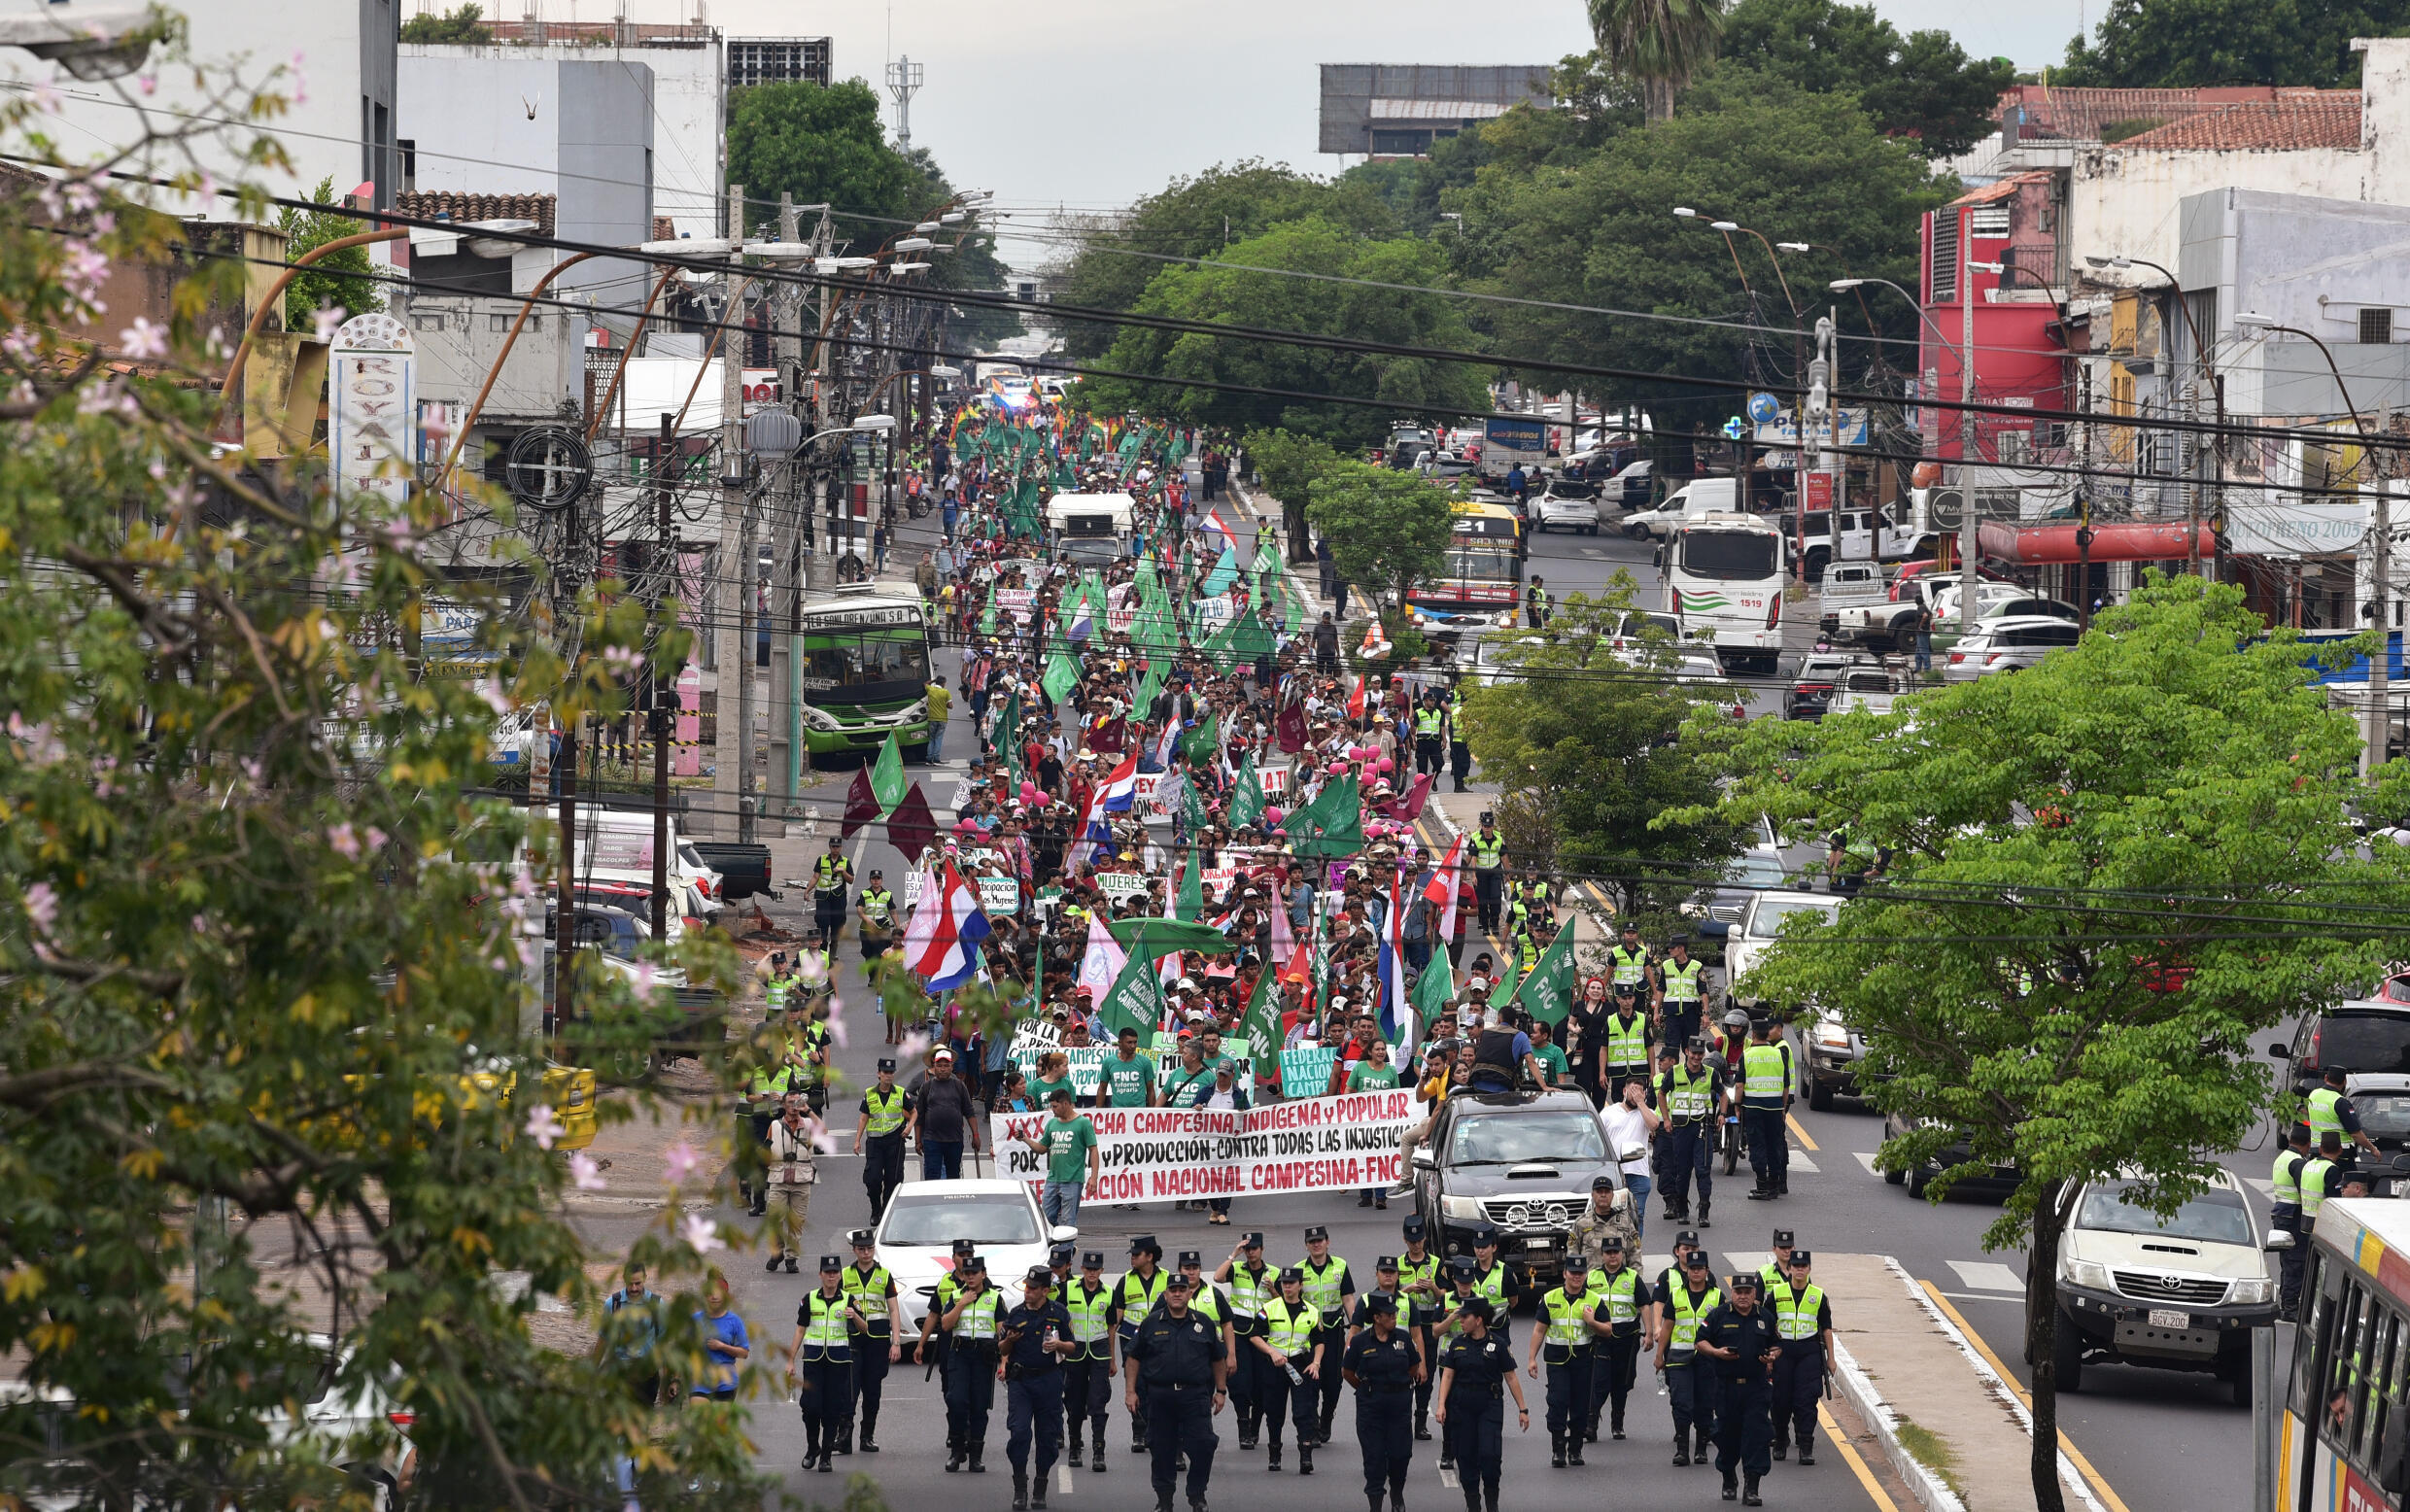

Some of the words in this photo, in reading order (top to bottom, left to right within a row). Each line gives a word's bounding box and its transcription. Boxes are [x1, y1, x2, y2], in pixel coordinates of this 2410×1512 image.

[2323, 520, 2361, 538] 2005
[1740, 599, 1762, 608] 1519
[1097, 874, 1146, 890] MUJERES
[1113, 1071, 1140, 1082] FNC
[1362, 1077, 1391, 1088] FNC
[1242, 1101, 1322, 1133] INDÍGENA
[1324, 1106, 1334, 1123] y
[1336, 1092, 1410, 1123] POPULAR
[1010, 1150, 1041, 1174] POR
[1273, 1130, 1314, 1156] TODAS
[1318, 1128, 1342, 1152] LAS
[1153, 1166, 1246, 1196] NACIONAL
[1251, 1153, 1402, 1191] CAMPESINA-FNC
